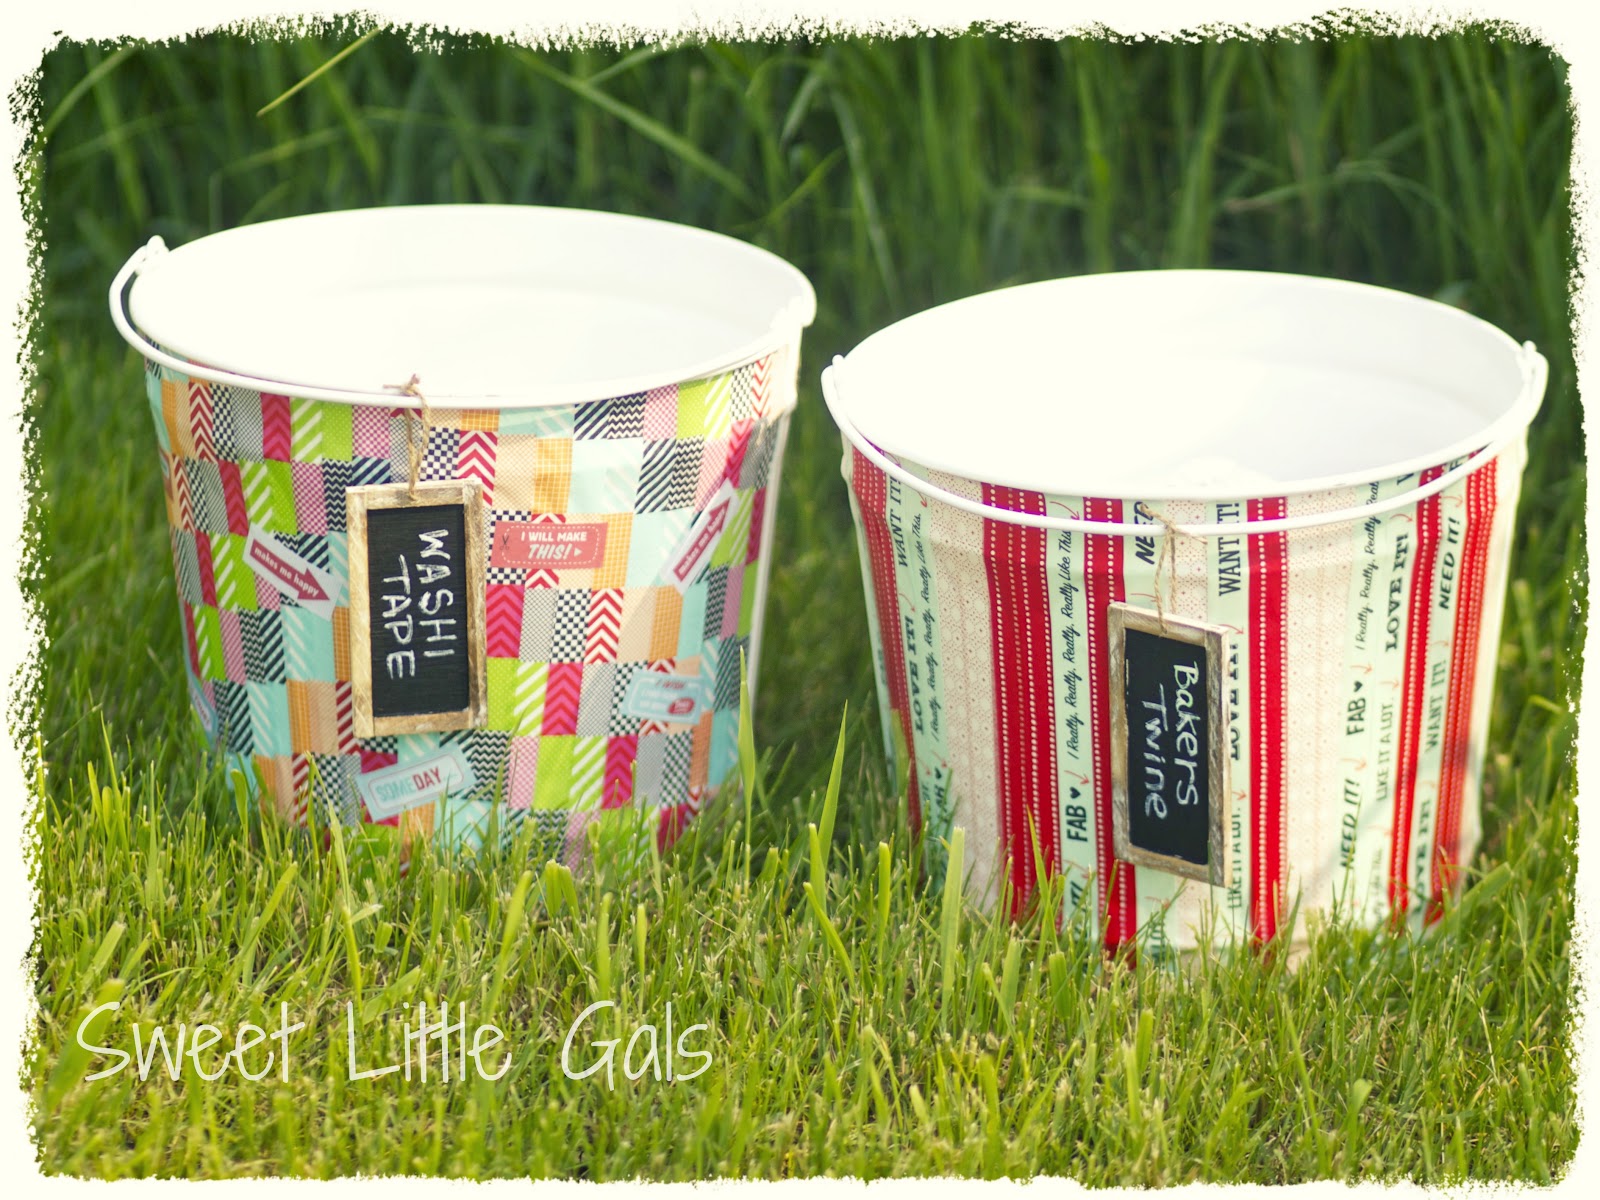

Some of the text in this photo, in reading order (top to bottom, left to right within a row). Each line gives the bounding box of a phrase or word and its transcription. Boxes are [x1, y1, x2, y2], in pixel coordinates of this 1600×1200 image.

[521, 531, 588, 542] I WILL MAKE
[528, 543, 573, 560] THIS!
[890, 508, 908, 568] WANT
[1216, 502, 1241, 597] WANT T!
[254, 547, 320, 598] makes me happy
[1057, 557, 1071, 581] Like
[1438, 516, 1460, 610] NEED IT!
[381, 554, 416, 680] TAPE
[416, 529, 457, 658] WASHI
[1059, 582, 1079, 619] Really
[1385, 532, 1409, 652] LOVE IT!
[909, 659, 924, 735] LOVE
[1346, 697, 1366, 736] FAB
[1173, 660, 1201, 806] Bakers
[1380, 732, 1392, 744] A
[1424, 693, 1443, 754] WANT
[1141, 683, 1168, 820] Twine
[1378, 750, 1391, 764] IT
[1344, 778, 1360, 806] IT!
[1376, 767, 1390, 802] LIKE
[1066, 804, 1088, 842] FAB
